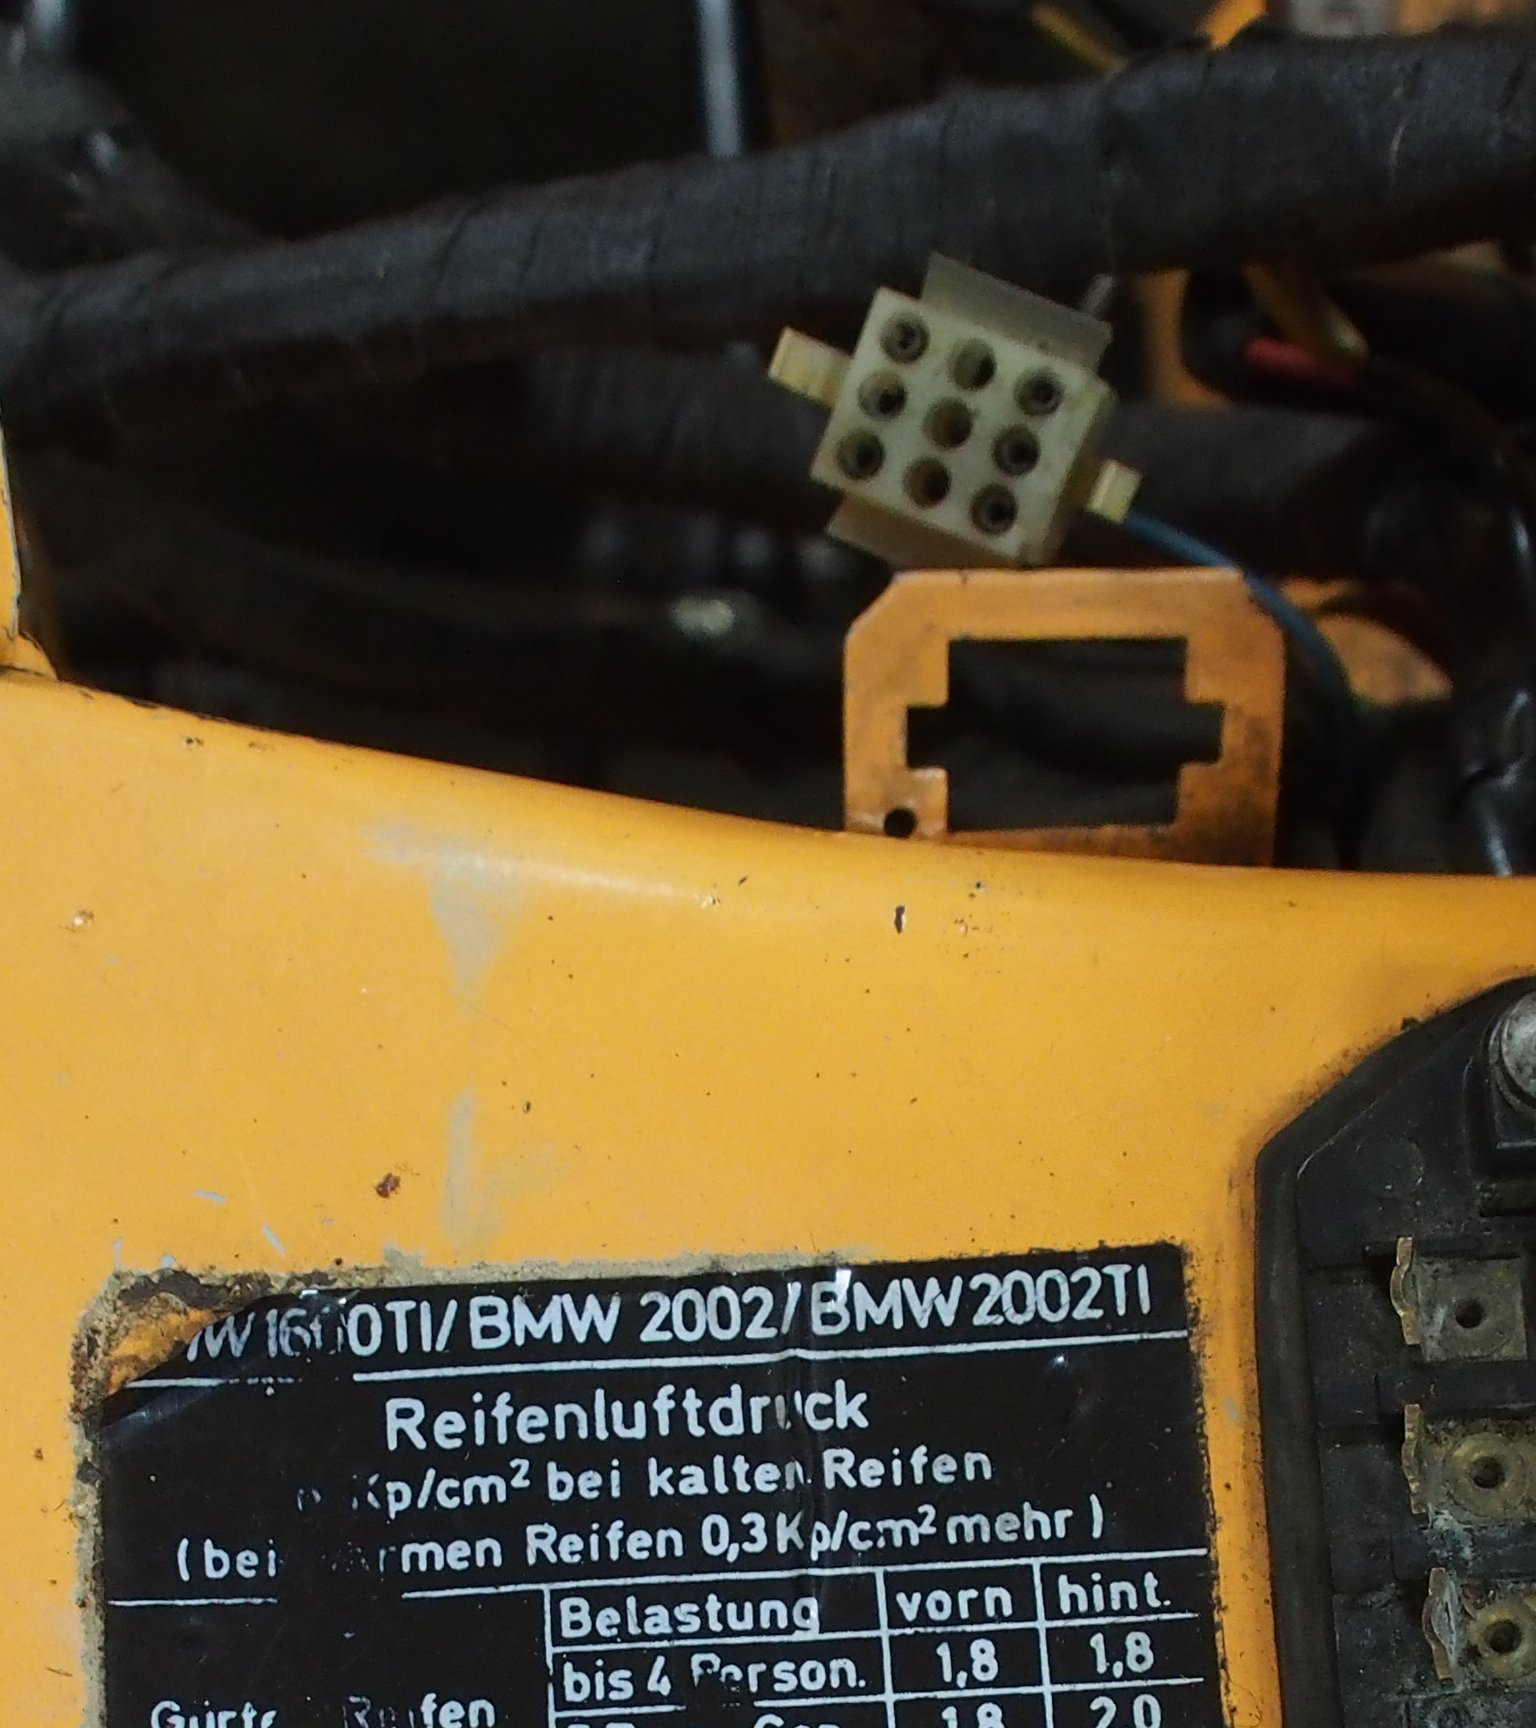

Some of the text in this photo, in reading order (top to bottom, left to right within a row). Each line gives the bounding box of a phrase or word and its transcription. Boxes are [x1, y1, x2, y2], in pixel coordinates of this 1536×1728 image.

[547, 1457, 622, 1502] bei
[648, 1455, 803, 1496] kalten
[823, 1445, 991, 1489] Reifen
[526, 1520, 683, 1565] Reifen
[560, 1571, 1173, 1640] Belastung vorn hint.
[564, 1662, 633, 1702] bis
[648, 1656, 671, 1695] 4
[937, 1639, 1004, 1692] 1,8
[1090, 1632, 1153, 1678] 1,8
